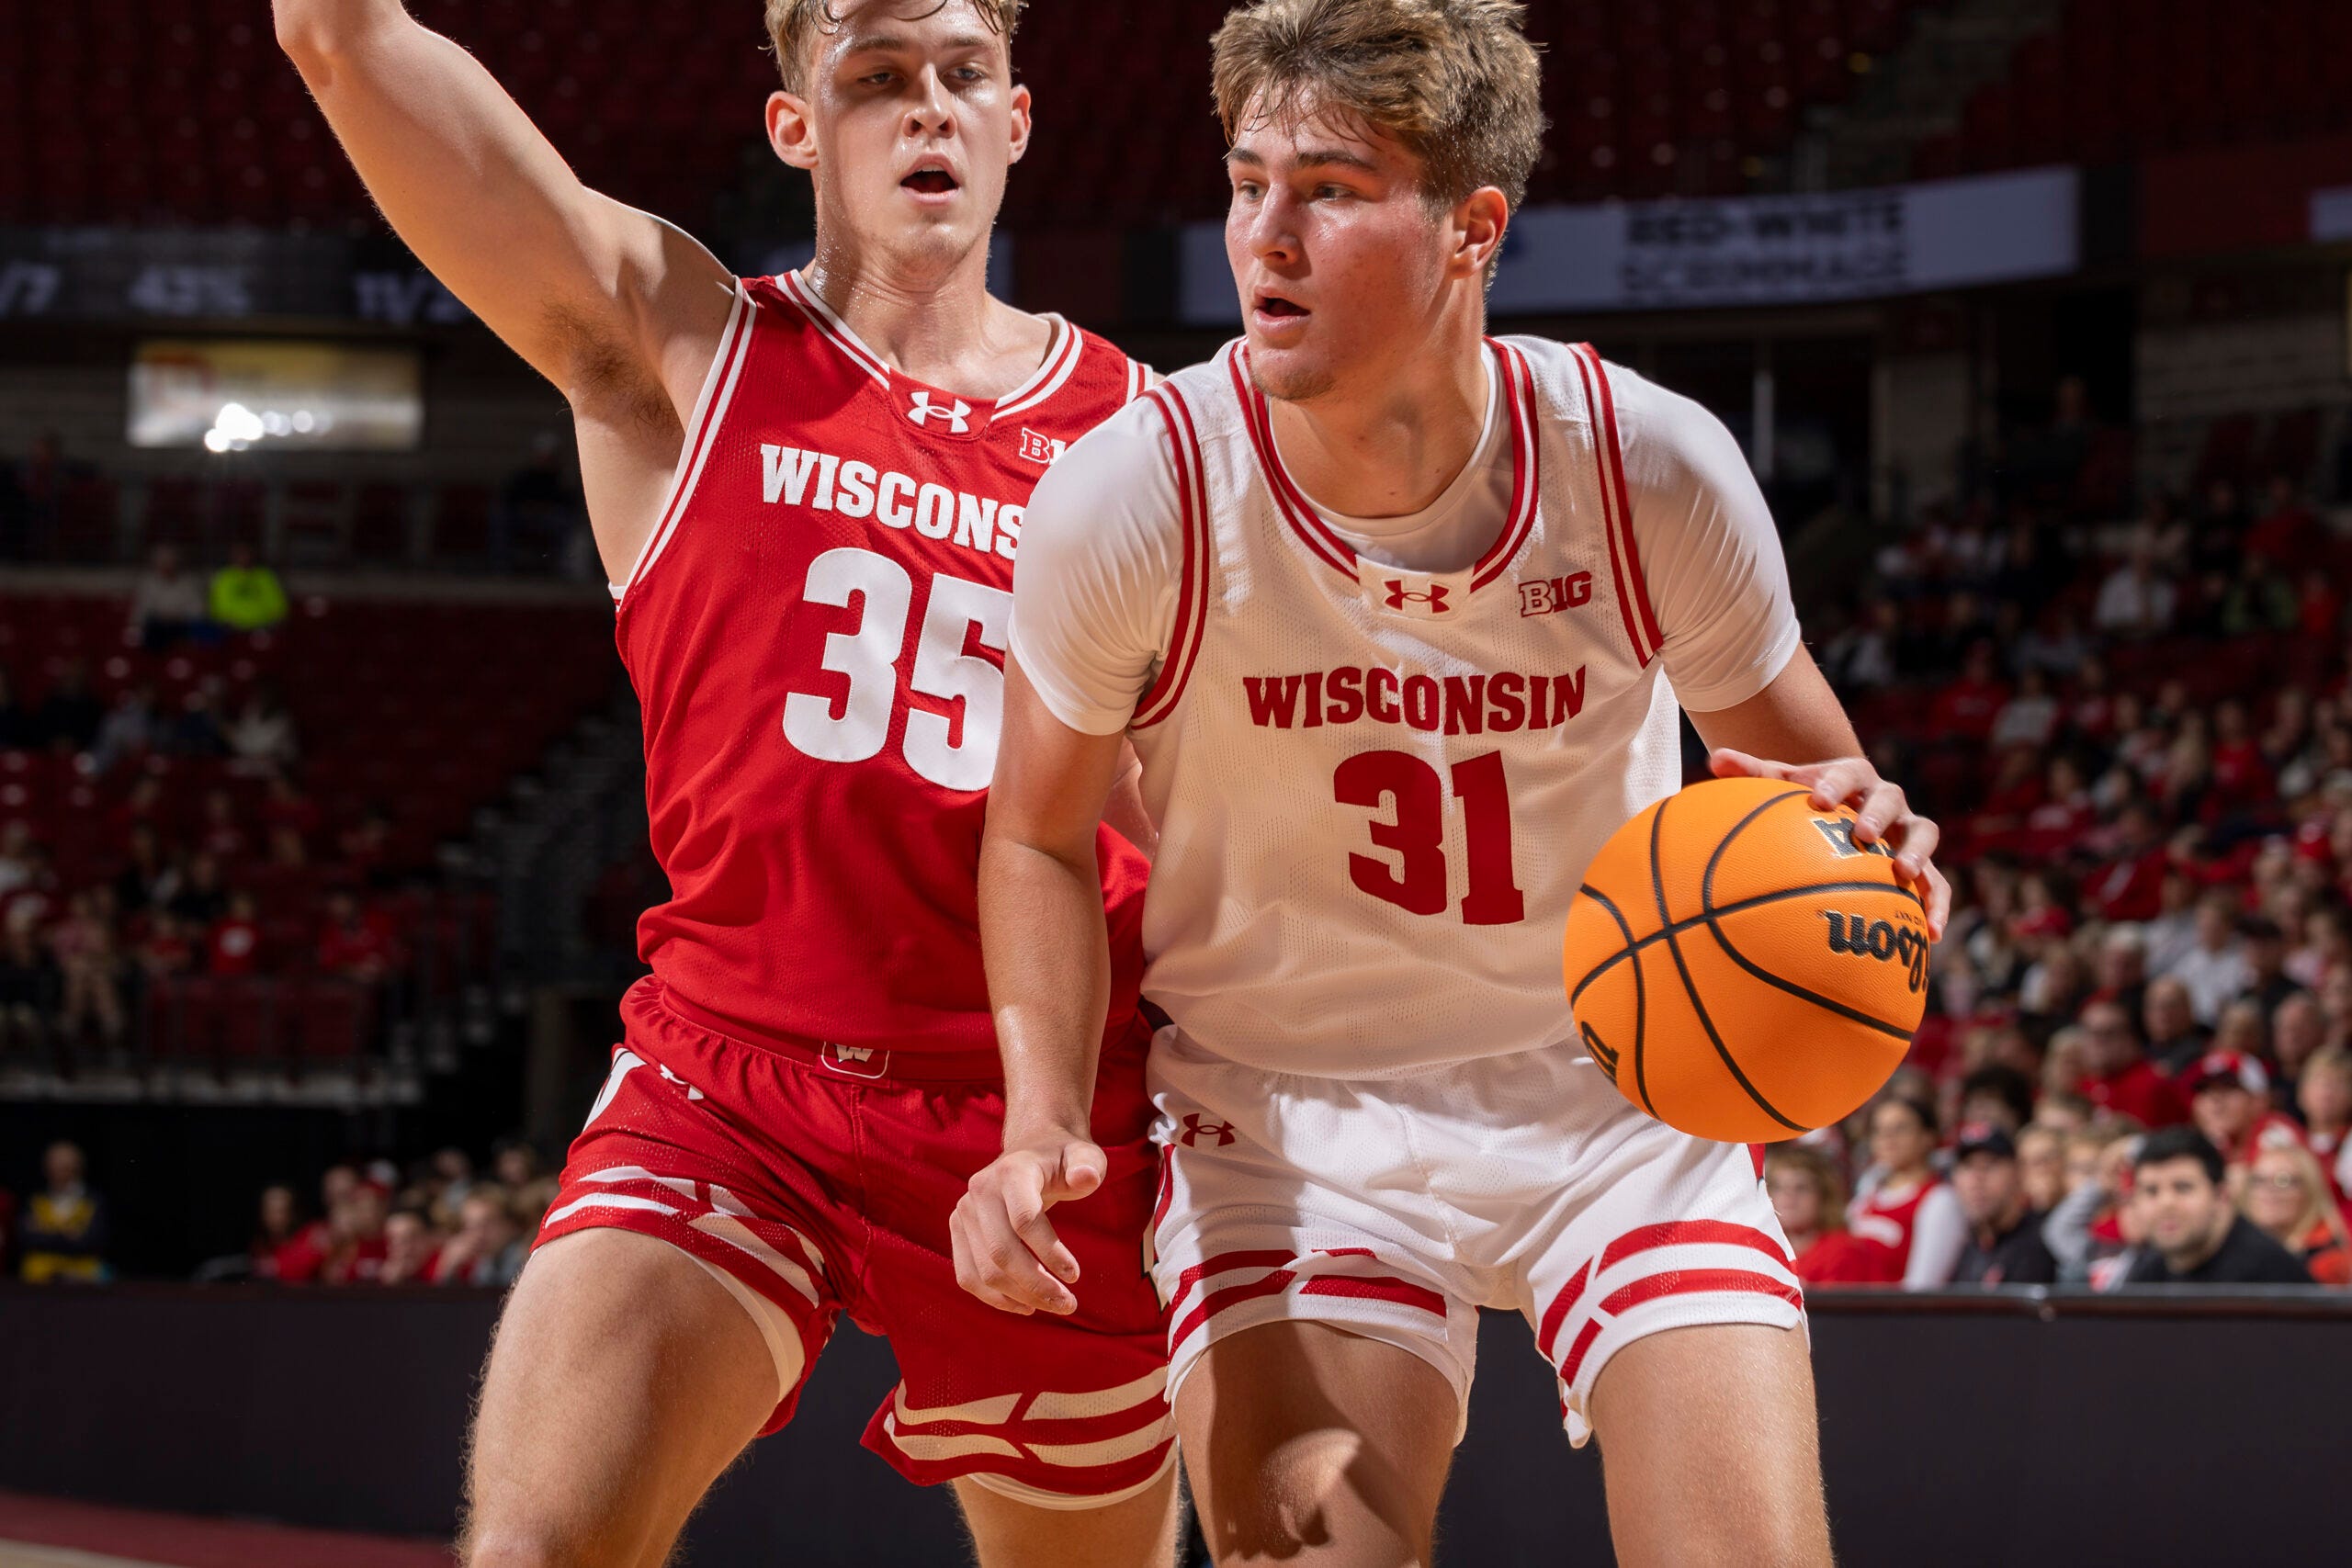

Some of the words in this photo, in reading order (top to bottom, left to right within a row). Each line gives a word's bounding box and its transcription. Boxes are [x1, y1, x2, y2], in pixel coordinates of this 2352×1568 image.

[783, 547, 1014, 791] 35
[1242, 665, 1586, 736] WISCONSIN
[1333, 750, 1525, 926] 31
